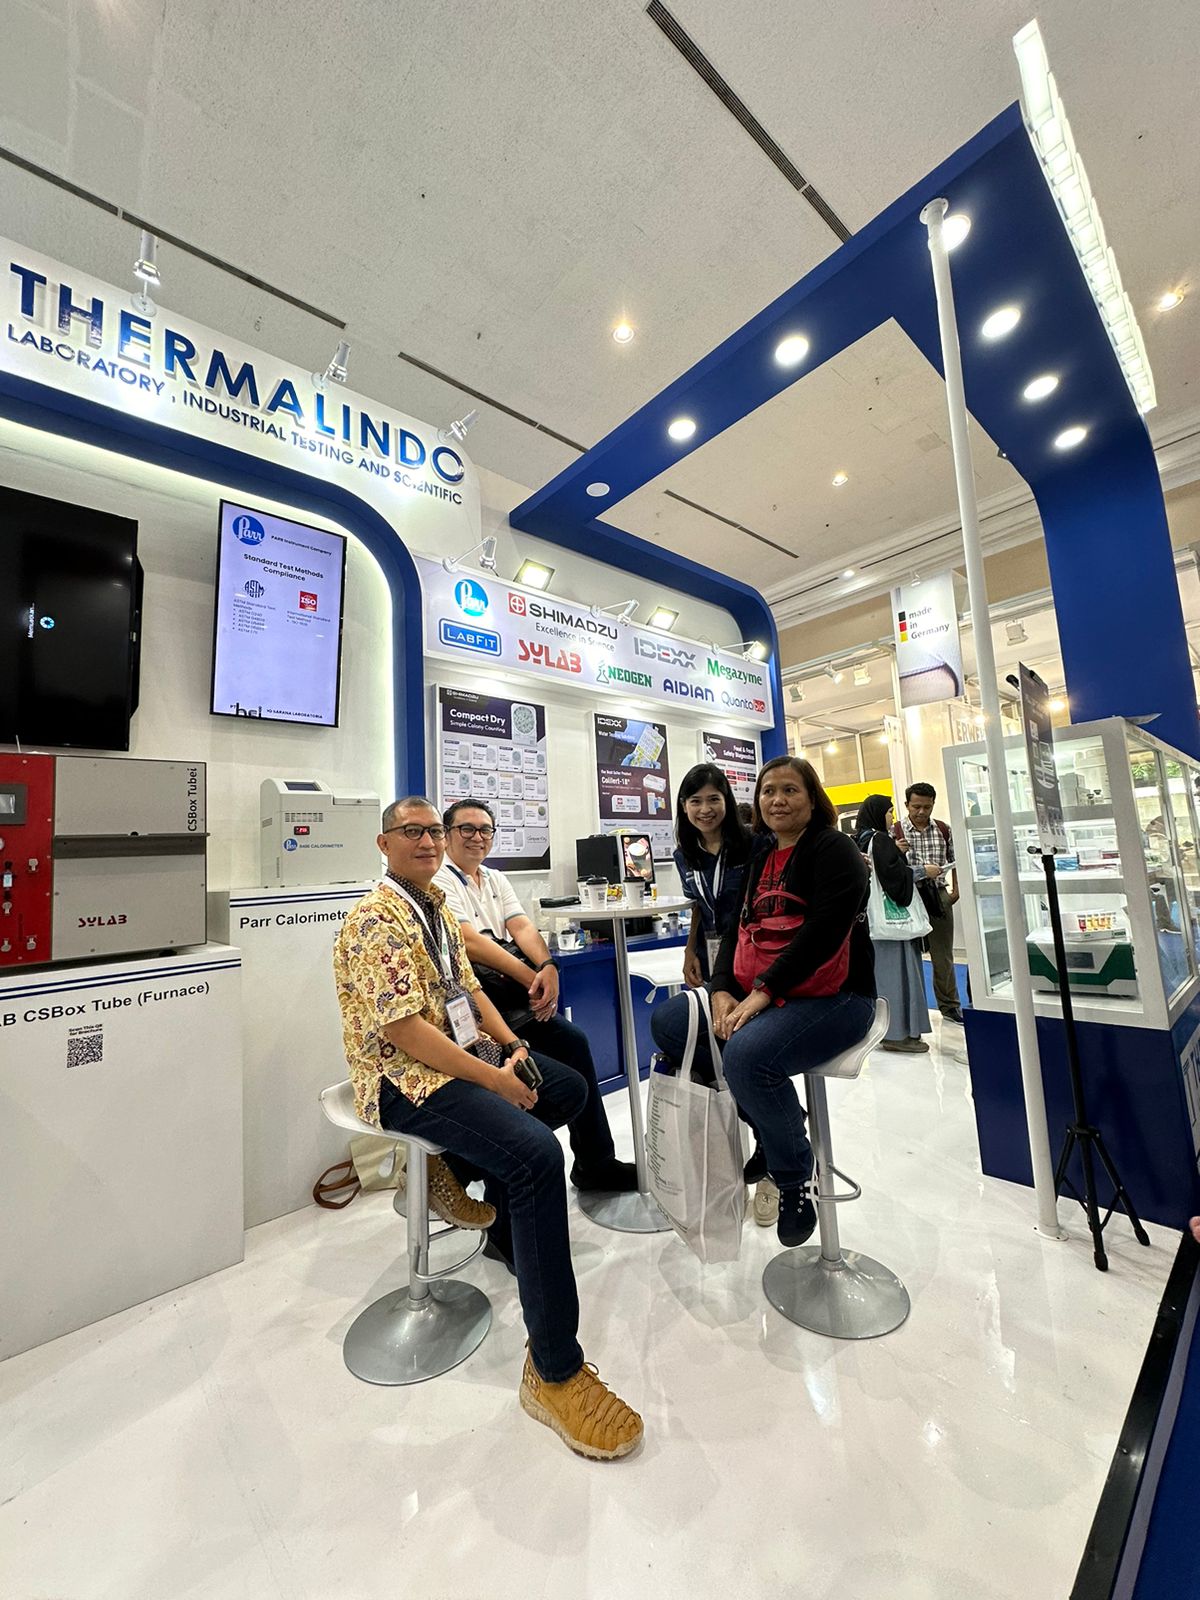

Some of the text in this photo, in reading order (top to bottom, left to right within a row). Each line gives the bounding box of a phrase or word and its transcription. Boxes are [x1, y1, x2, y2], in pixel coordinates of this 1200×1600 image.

[10, 263, 466, 484] THERMALINDO
[8, 323, 166, 395] LABORATORY
[183, 390, 287, 441] INDUSTRIAL
[291, 431, 354, 465] TESTING
[358, 458, 391, 478] AND
[393, 470, 463, 505] SCENTIFIC
[243, 553, 324, 579] Standard Test Methods
[263, 566, 306, 581] Compliance
[244, 580, 265, 598] ASTM
[300, 597, 317, 607] ISO
[529, 603, 619, 640] SHIMADZU
[908, 606, 932, 620] made
[536, 622, 577, 642] Excellence
[910, 622, 918, 630] in
[911, 623, 950, 640] Germany
[447, 628, 496, 648] LABFIT
[518, 639, 582, 674] SYLAB
[633, 637, 697, 670] IDEXX
[608, 665, 652, 688] NEOGEN
[706, 657, 763, 686] Megazyme
[663, 678, 715, 702] AIDIAN
[450, 708, 506, 726] Compact Dry
[450, 720, 506, 734] Simple Colony Counting
[597, 717, 622, 728] IDEXX
[187, 799, 198, 832] CSBox
[78, 914, 128, 928] SYLAB
[240, 910, 349, 929] Parr Calorimete
[23, 1003, 86, 1023] CSBox
[92, 996, 133, 1012] Tube
[137, 981, 210, 1007] (Furnace)
